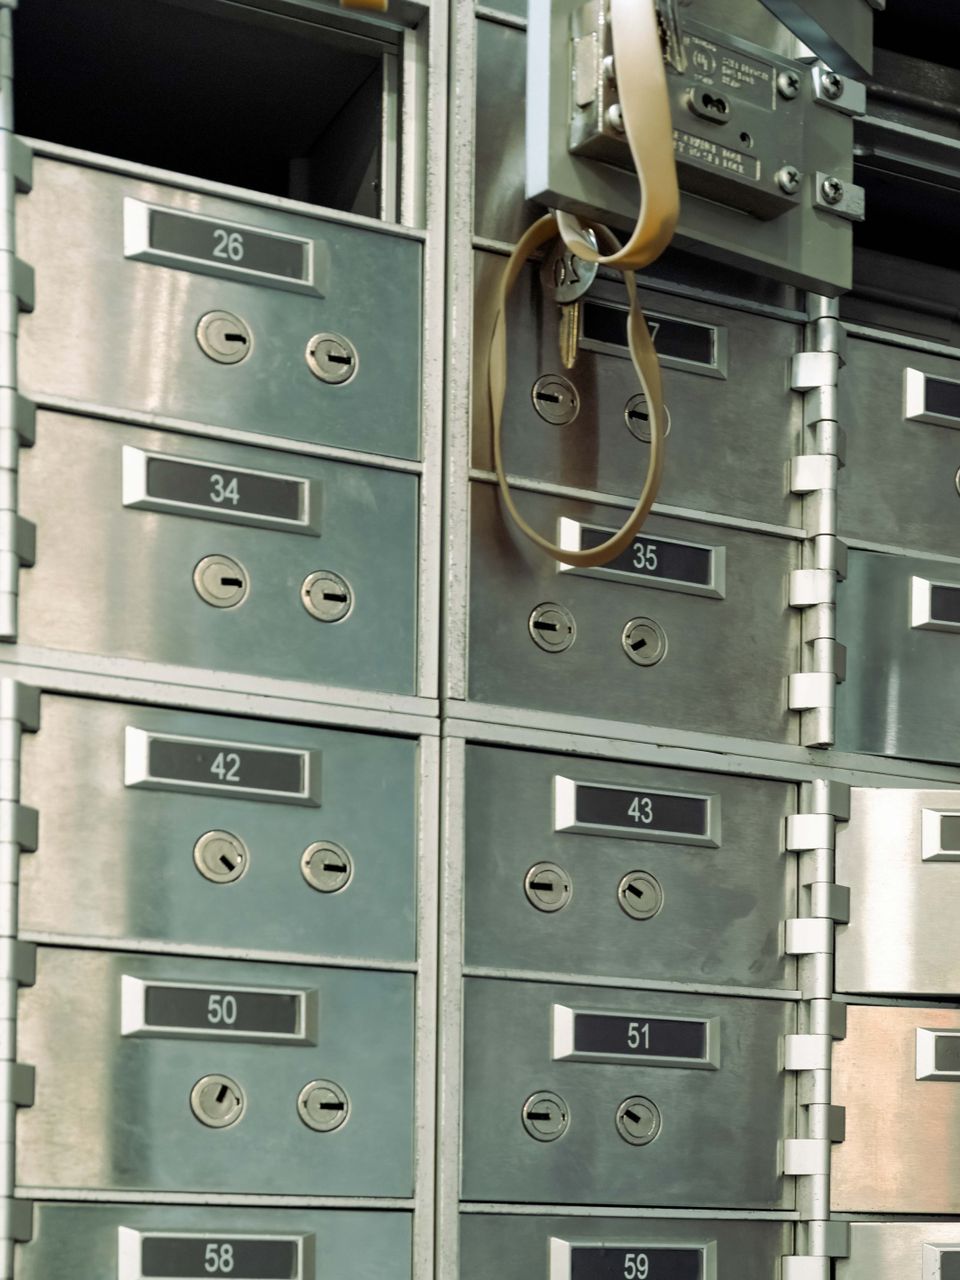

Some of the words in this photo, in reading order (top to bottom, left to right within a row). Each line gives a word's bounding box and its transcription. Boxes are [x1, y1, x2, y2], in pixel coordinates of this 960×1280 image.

[213, 230, 242, 261] 26
[210, 474, 239, 505] 34
[633, 543, 657, 571] 35
[210, 753, 240, 782] 42
[627, 797, 652, 824] 43
[207, 995, 236, 1025] 50
[627, 1023, 648, 1049] 51
[204, 1244, 233, 1273] 58
[623, 1254, 648, 1280] 59
